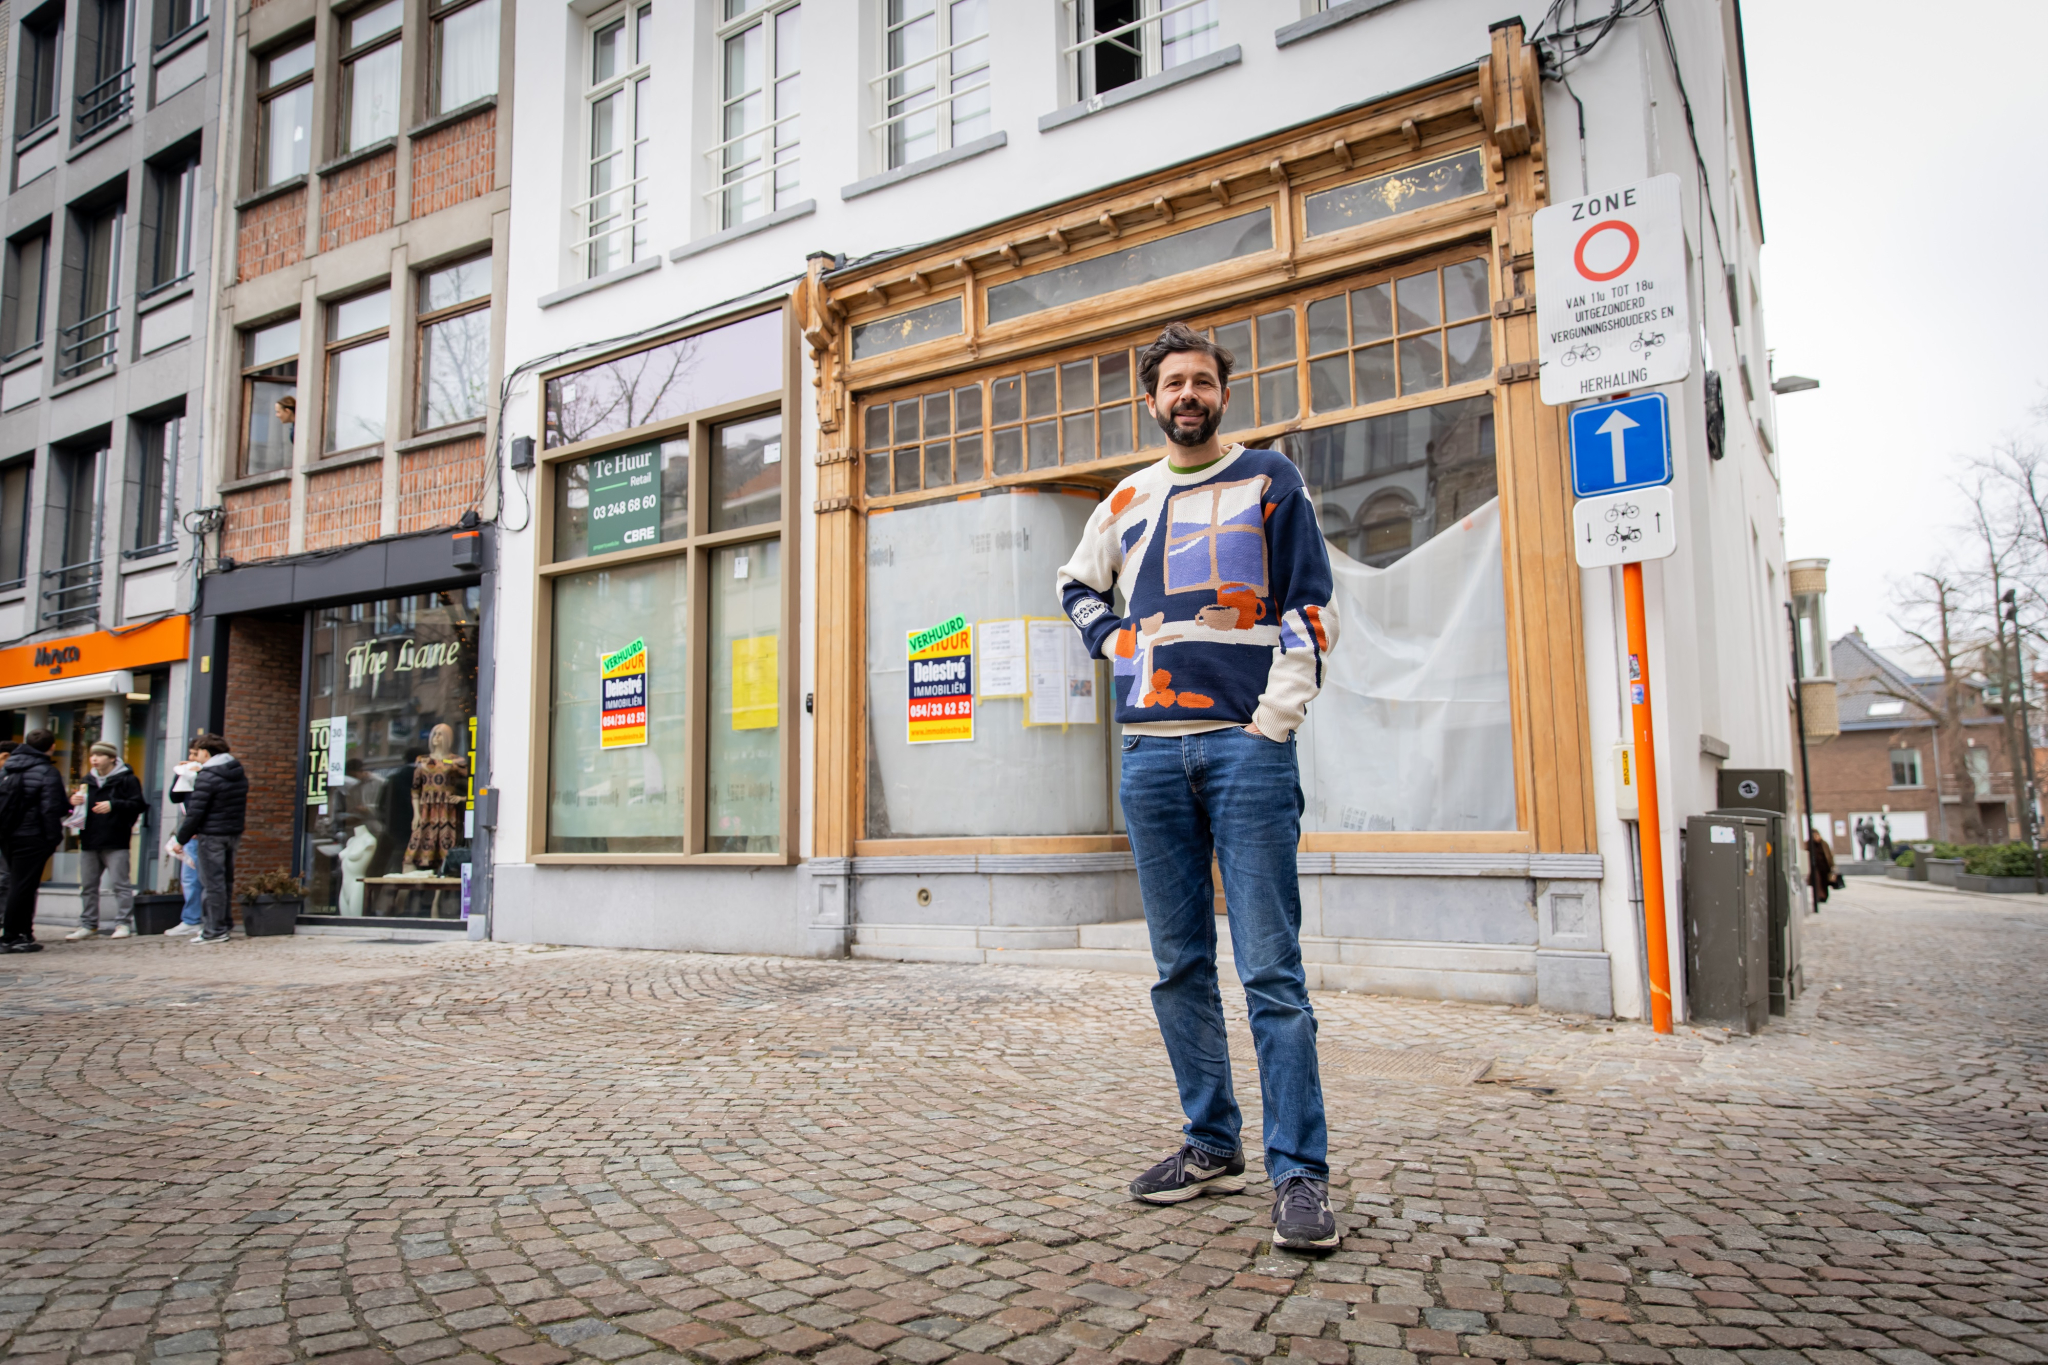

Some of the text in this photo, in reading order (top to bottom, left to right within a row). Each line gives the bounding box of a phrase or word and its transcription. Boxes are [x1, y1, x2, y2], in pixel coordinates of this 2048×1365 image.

[1571, 188, 1637, 222] ZONE
[1565, 280, 1654, 310] VAN 11u TOT 18u
[1575, 296, 1645, 323] UITGEZONDERD
[1550, 305, 1674, 344] VERGUNNINGSHOUDERS EN
[1644, 351, 1652, 361] P
[1580, 367, 1648, 394] HERHALING
[594, 452, 652, 479] Te Huur
[630, 471, 652, 487] Retail
[593, 494, 656, 520] 03 248 68 60
[623, 525, 655, 544] CBRE
[1621, 545, 1627, 554] P
[909, 616, 964, 651] VERHUURD
[345, 638, 460, 678] The Lane
[604, 640, 643, 671] VERHUURD
[913, 656, 966, 684] Delestré
[605, 674, 643, 698] Delestré
[913, 681, 966, 697] IMMOBILIËN
[605, 695, 643, 710] IMMOBILIËN
[910, 700, 970, 718] 054/33 62 52
[602, 711, 645, 727] 054/33 62 52
[310, 726, 331, 750] TO
[309, 750, 329, 773] TA
[308, 773, 328, 796] LE
